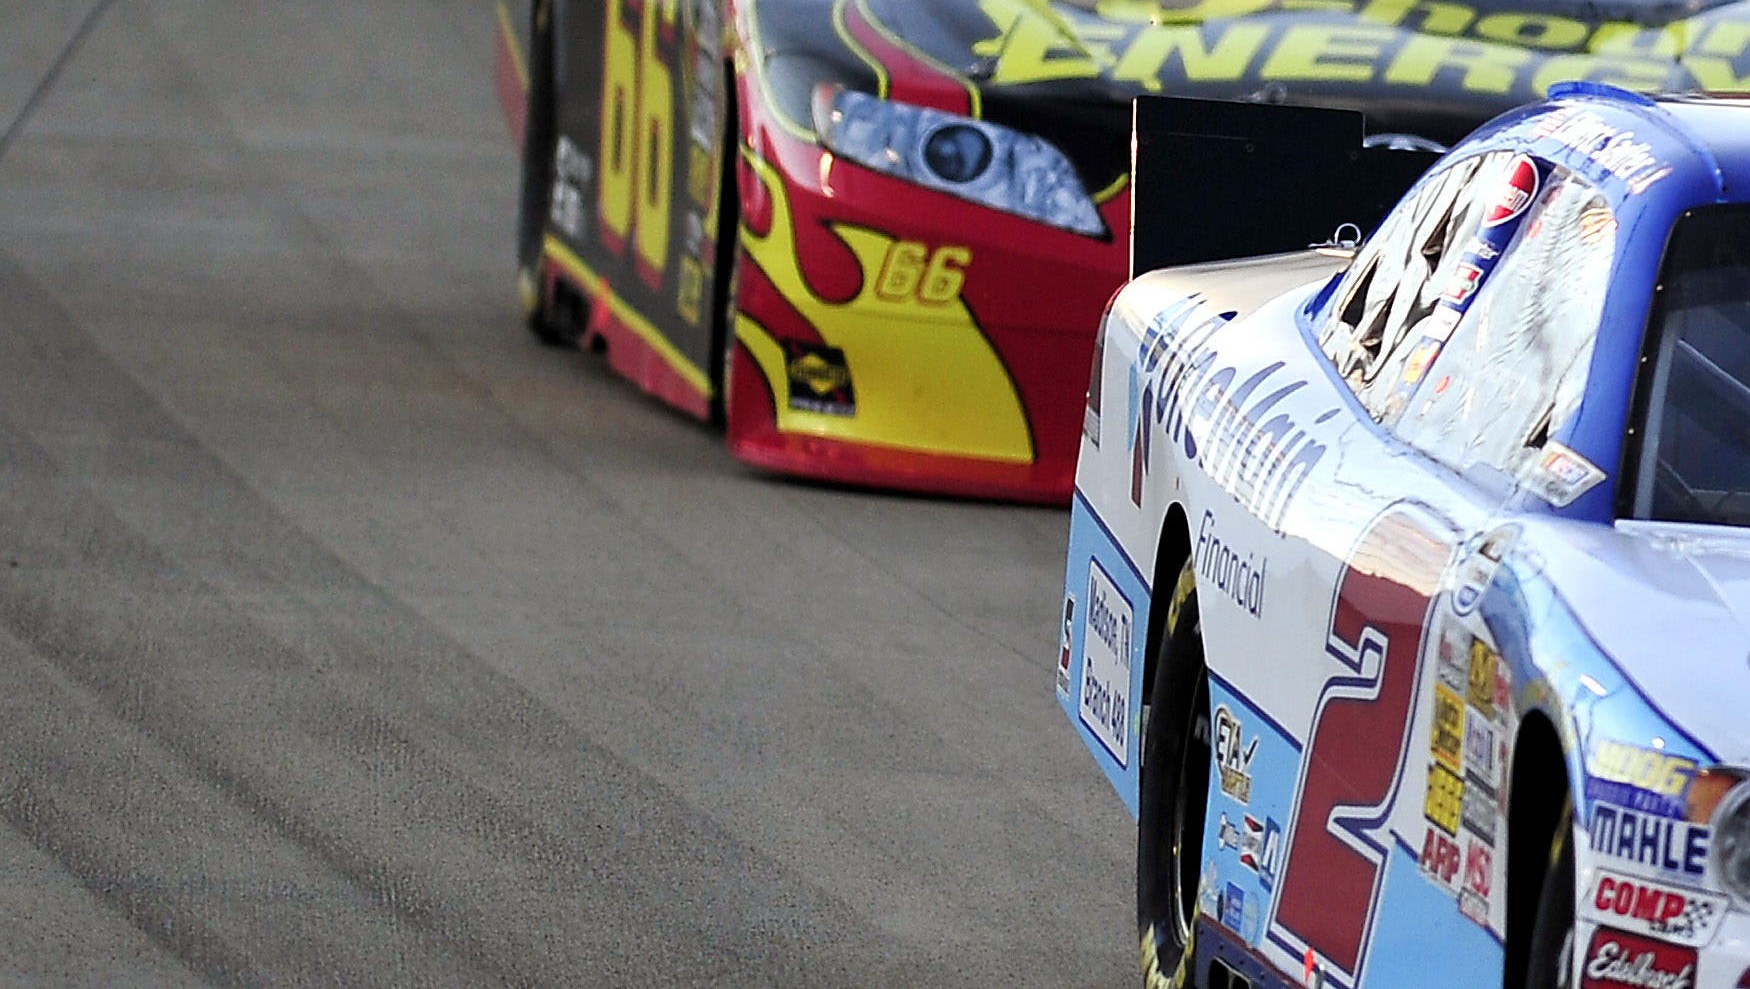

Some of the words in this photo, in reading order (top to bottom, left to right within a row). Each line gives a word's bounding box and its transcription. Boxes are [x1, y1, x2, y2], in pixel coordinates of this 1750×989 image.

[875, 241, 972, 308] 66
[1194, 510, 1267, 619] Financial
[1267, 499, 1458, 989] 2
[1590, 805, 1710, 875] MAHLE
[1594, 876, 1686, 922] COMP
